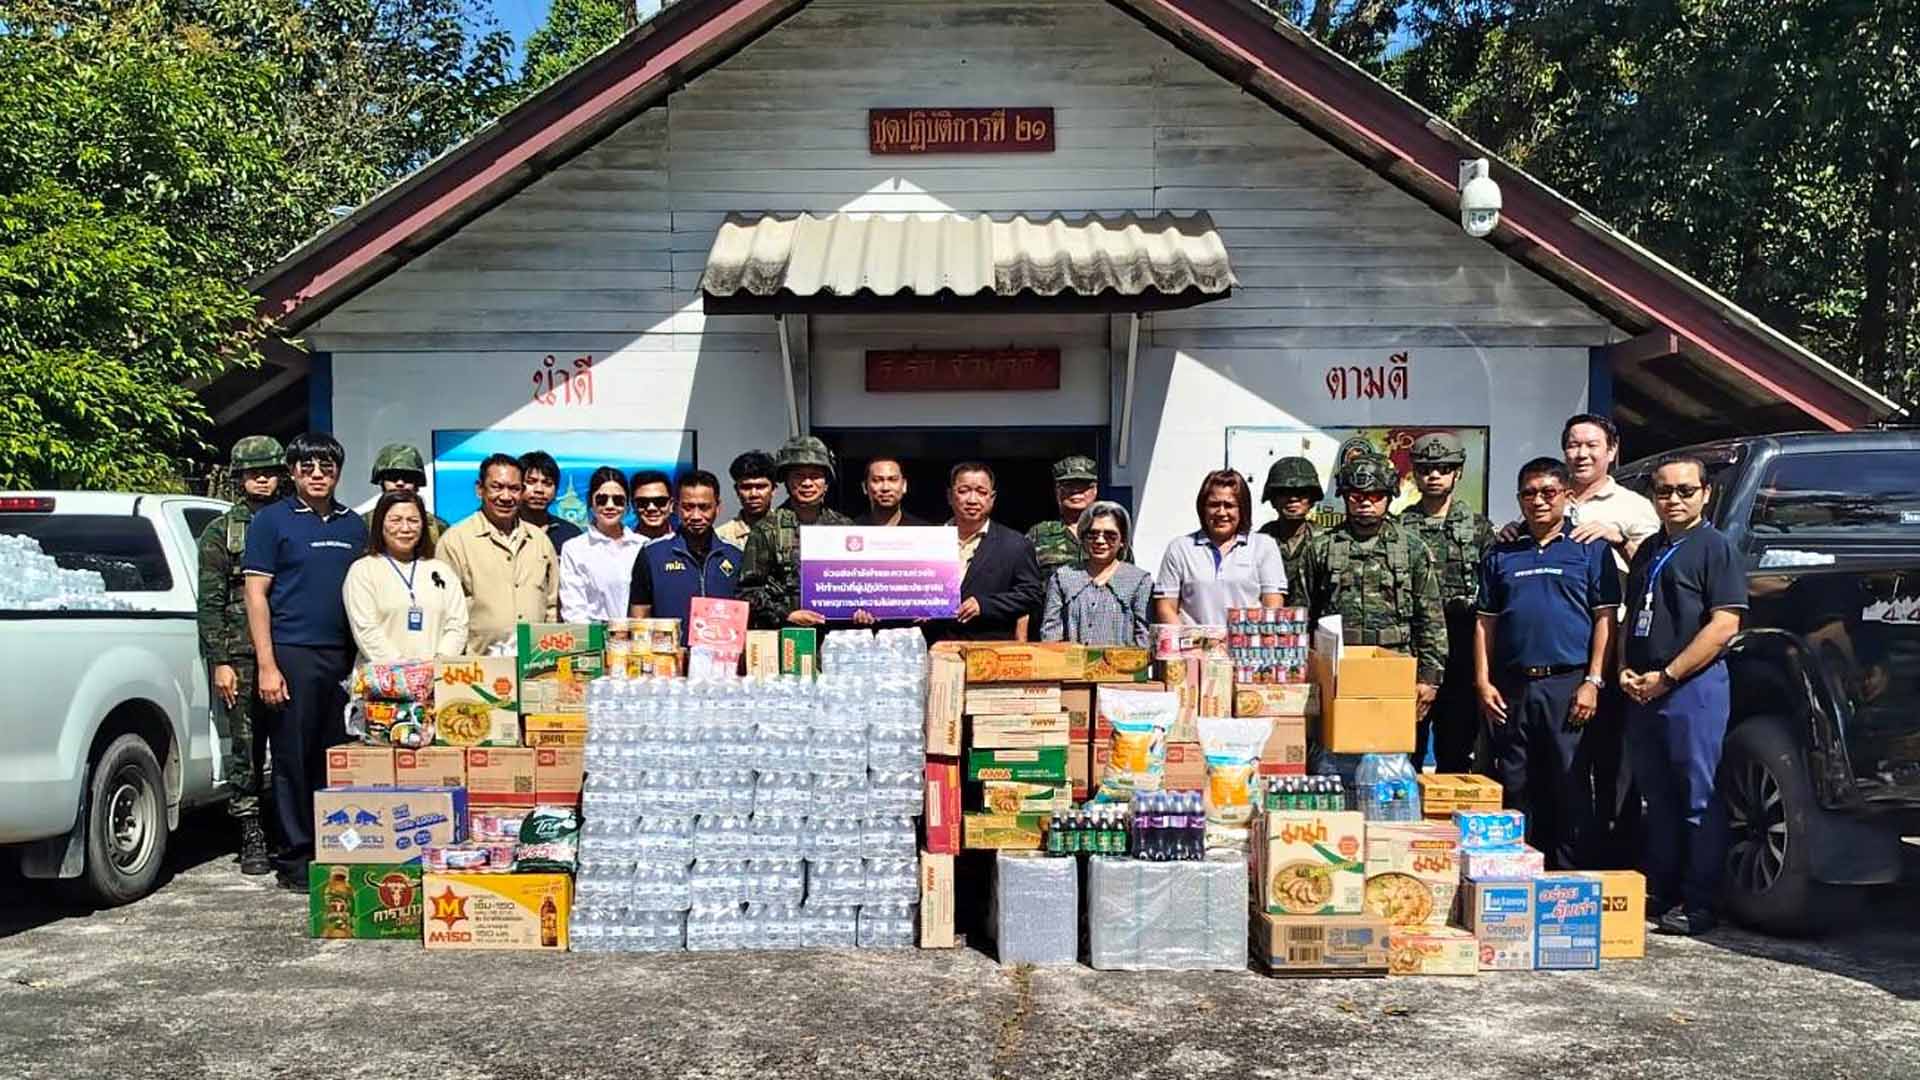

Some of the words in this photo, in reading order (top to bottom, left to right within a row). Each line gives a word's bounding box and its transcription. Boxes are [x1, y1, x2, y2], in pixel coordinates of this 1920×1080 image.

[873, 109, 1005, 150] ชุดปฏิบัติการที่
[1015, 115, 1046, 141] ๒๑
[533, 355, 593, 405] นำดี
[1326, 352, 1408, 400] ตามดี
[443, 661, 485, 685] มาม่า
[1281, 818, 1328, 845] มาม่า
[438, 900, 460, 918] M
[429, 931, 472, 943] M-150
